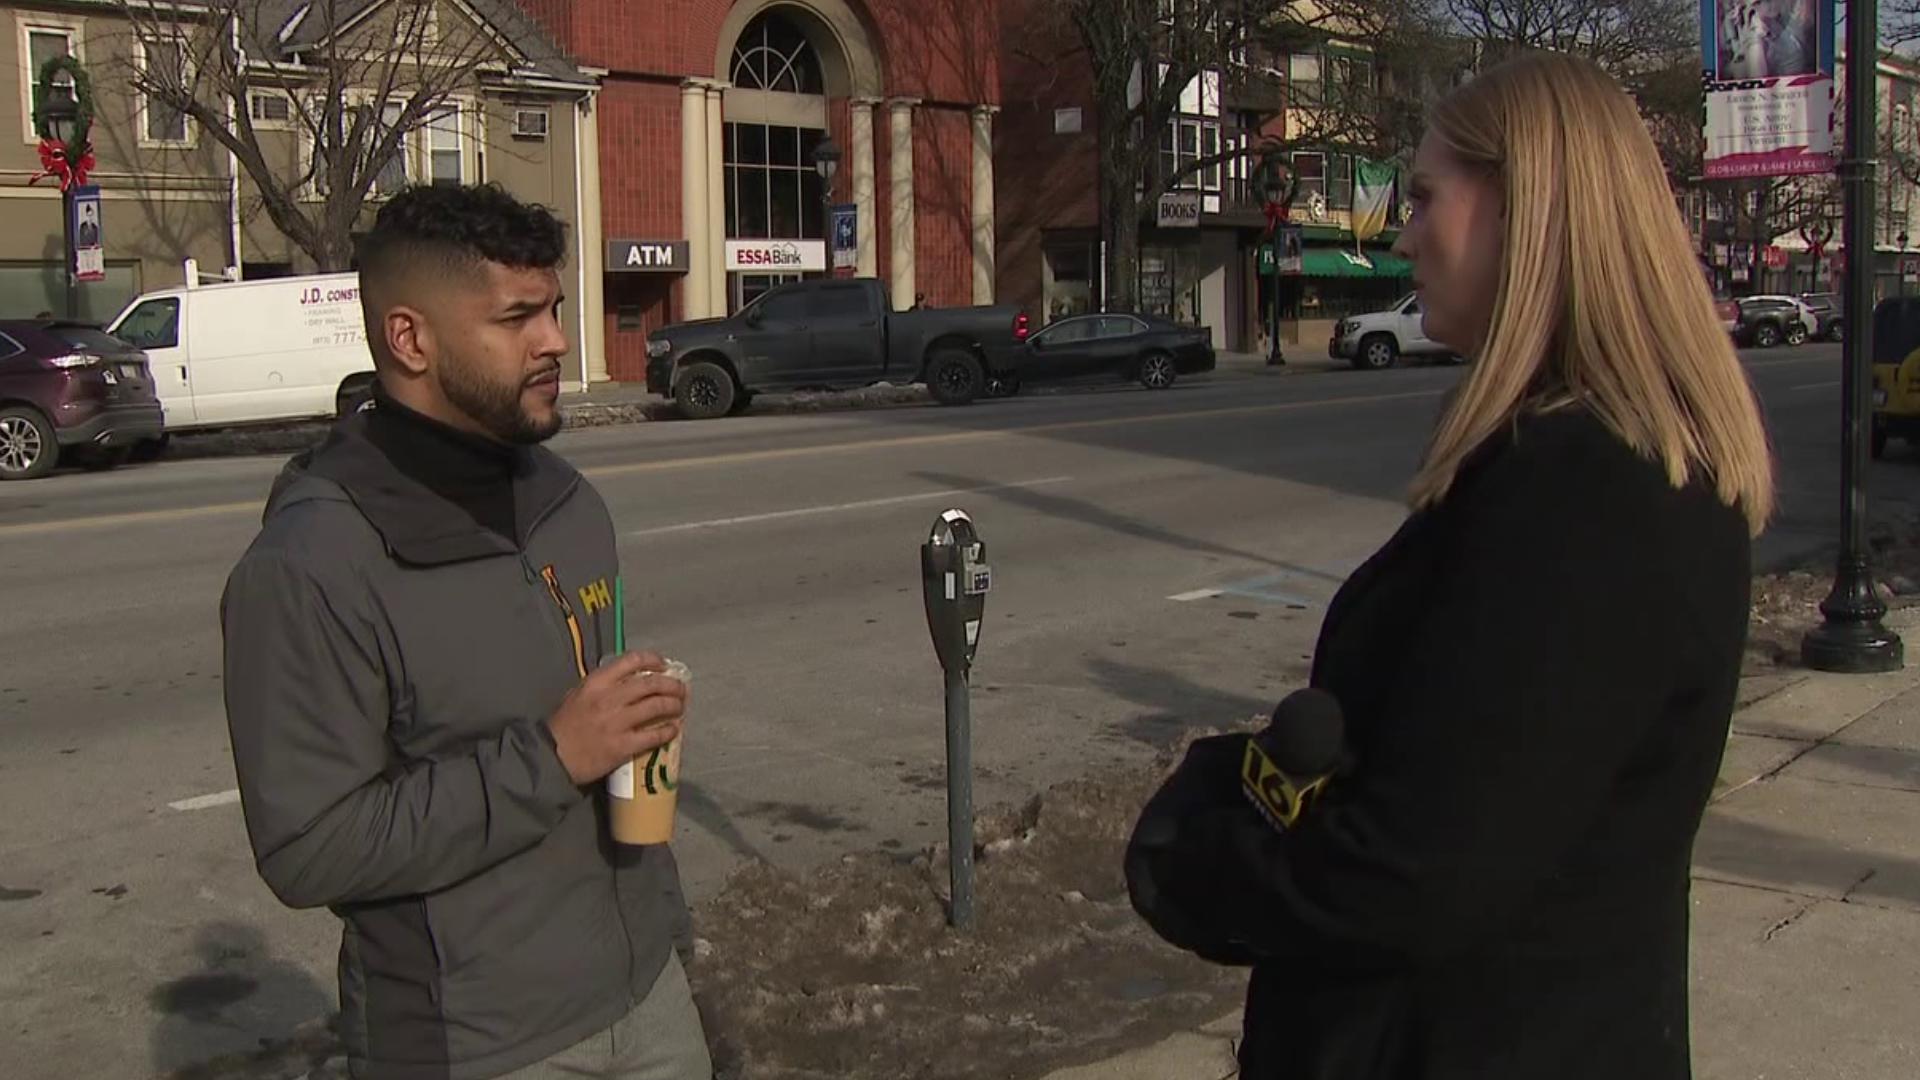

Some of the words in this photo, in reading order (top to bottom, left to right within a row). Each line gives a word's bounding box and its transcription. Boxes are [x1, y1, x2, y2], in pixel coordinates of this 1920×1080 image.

[1161, 203, 1197, 218] BOOKS
[627, 246, 673, 265] ATM
[300, 287, 324, 305] J.D.
[579, 578, 613, 616] HH
[1248, 746, 1291, 817] 16
